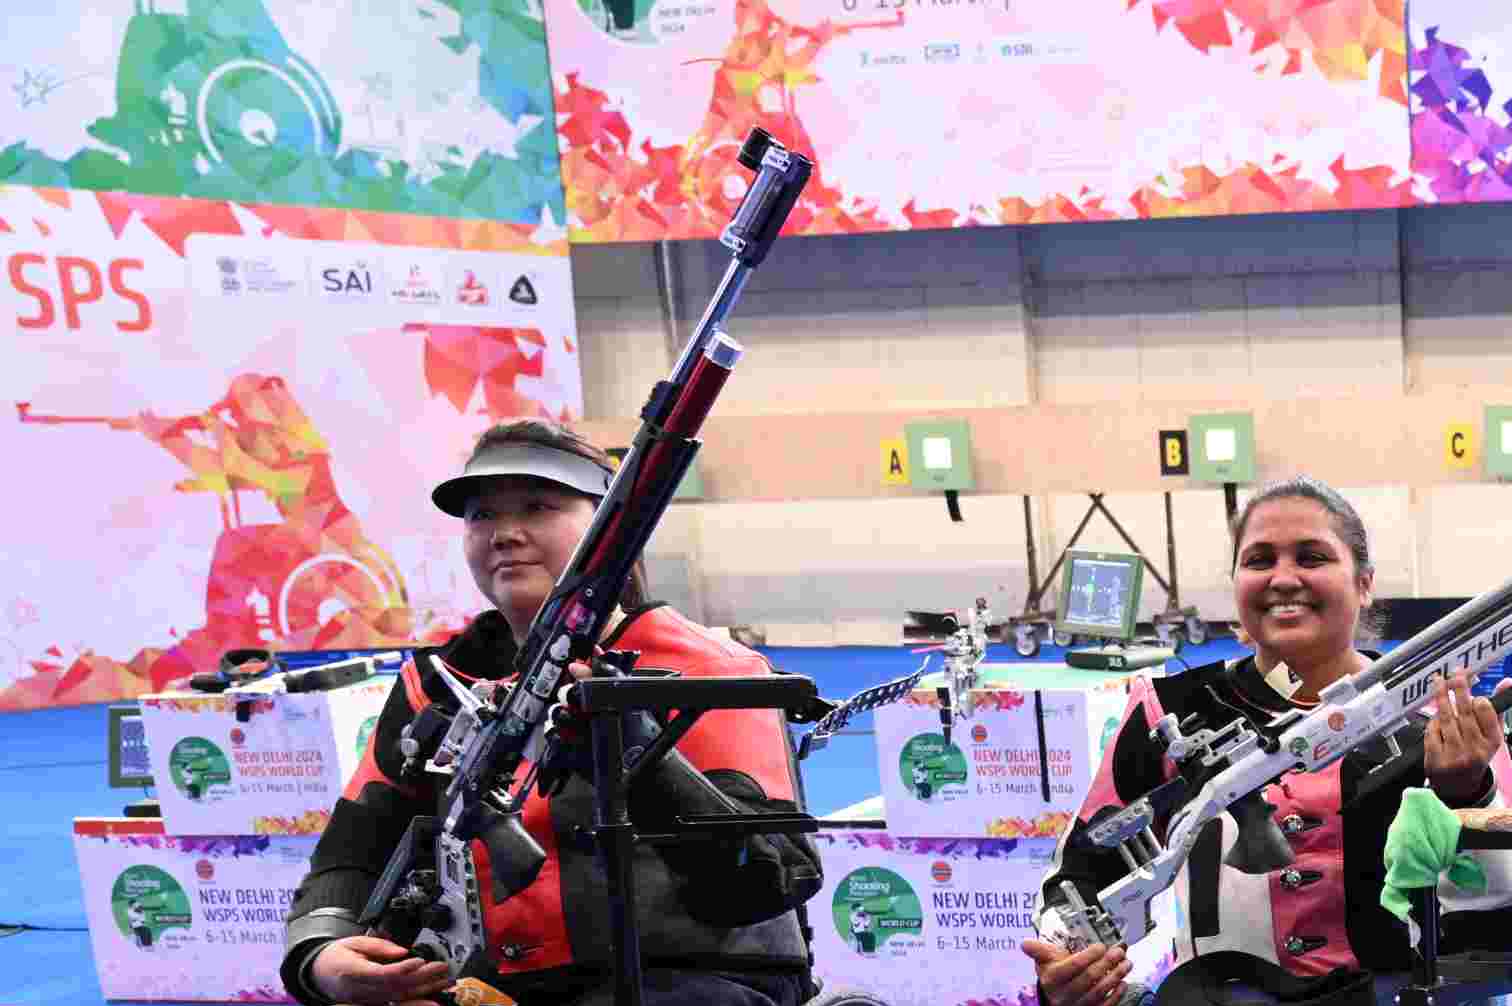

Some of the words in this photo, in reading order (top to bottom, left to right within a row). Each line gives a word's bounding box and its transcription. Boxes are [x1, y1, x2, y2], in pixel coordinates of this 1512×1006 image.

[7, 252, 153, 332] SPS
[1167, 438, 1182, 467] B
[1451, 432, 1465, 458] C
[889, 449, 903, 474] A
[263, 751, 293, 763] DELHI
[974, 750, 1001, 763] NEW
[1005, 750, 1039, 763] DELHI
[976, 765, 1006, 777] WSPS
[1051, 765, 1072, 777] CUP
[1006, 783, 1037, 793] March
[200, 888, 232, 905] NEW
[236, 888, 275, 905] DELHI
[279, 888, 298, 904] 20
[933, 892, 970, 909] NEW
[975, 892, 1018, 909] DELHI
[203, 908, 239, 923] WSPS
[936, 913, 976, 928] WSPS
[981, 913, 1033, 929] WORLD
[205, 930, 238, 944] 6-15
[241, 930, 278, 944] March
[936, 936, 970, 950] 6-15
[976, 936, 1016, 950] March
